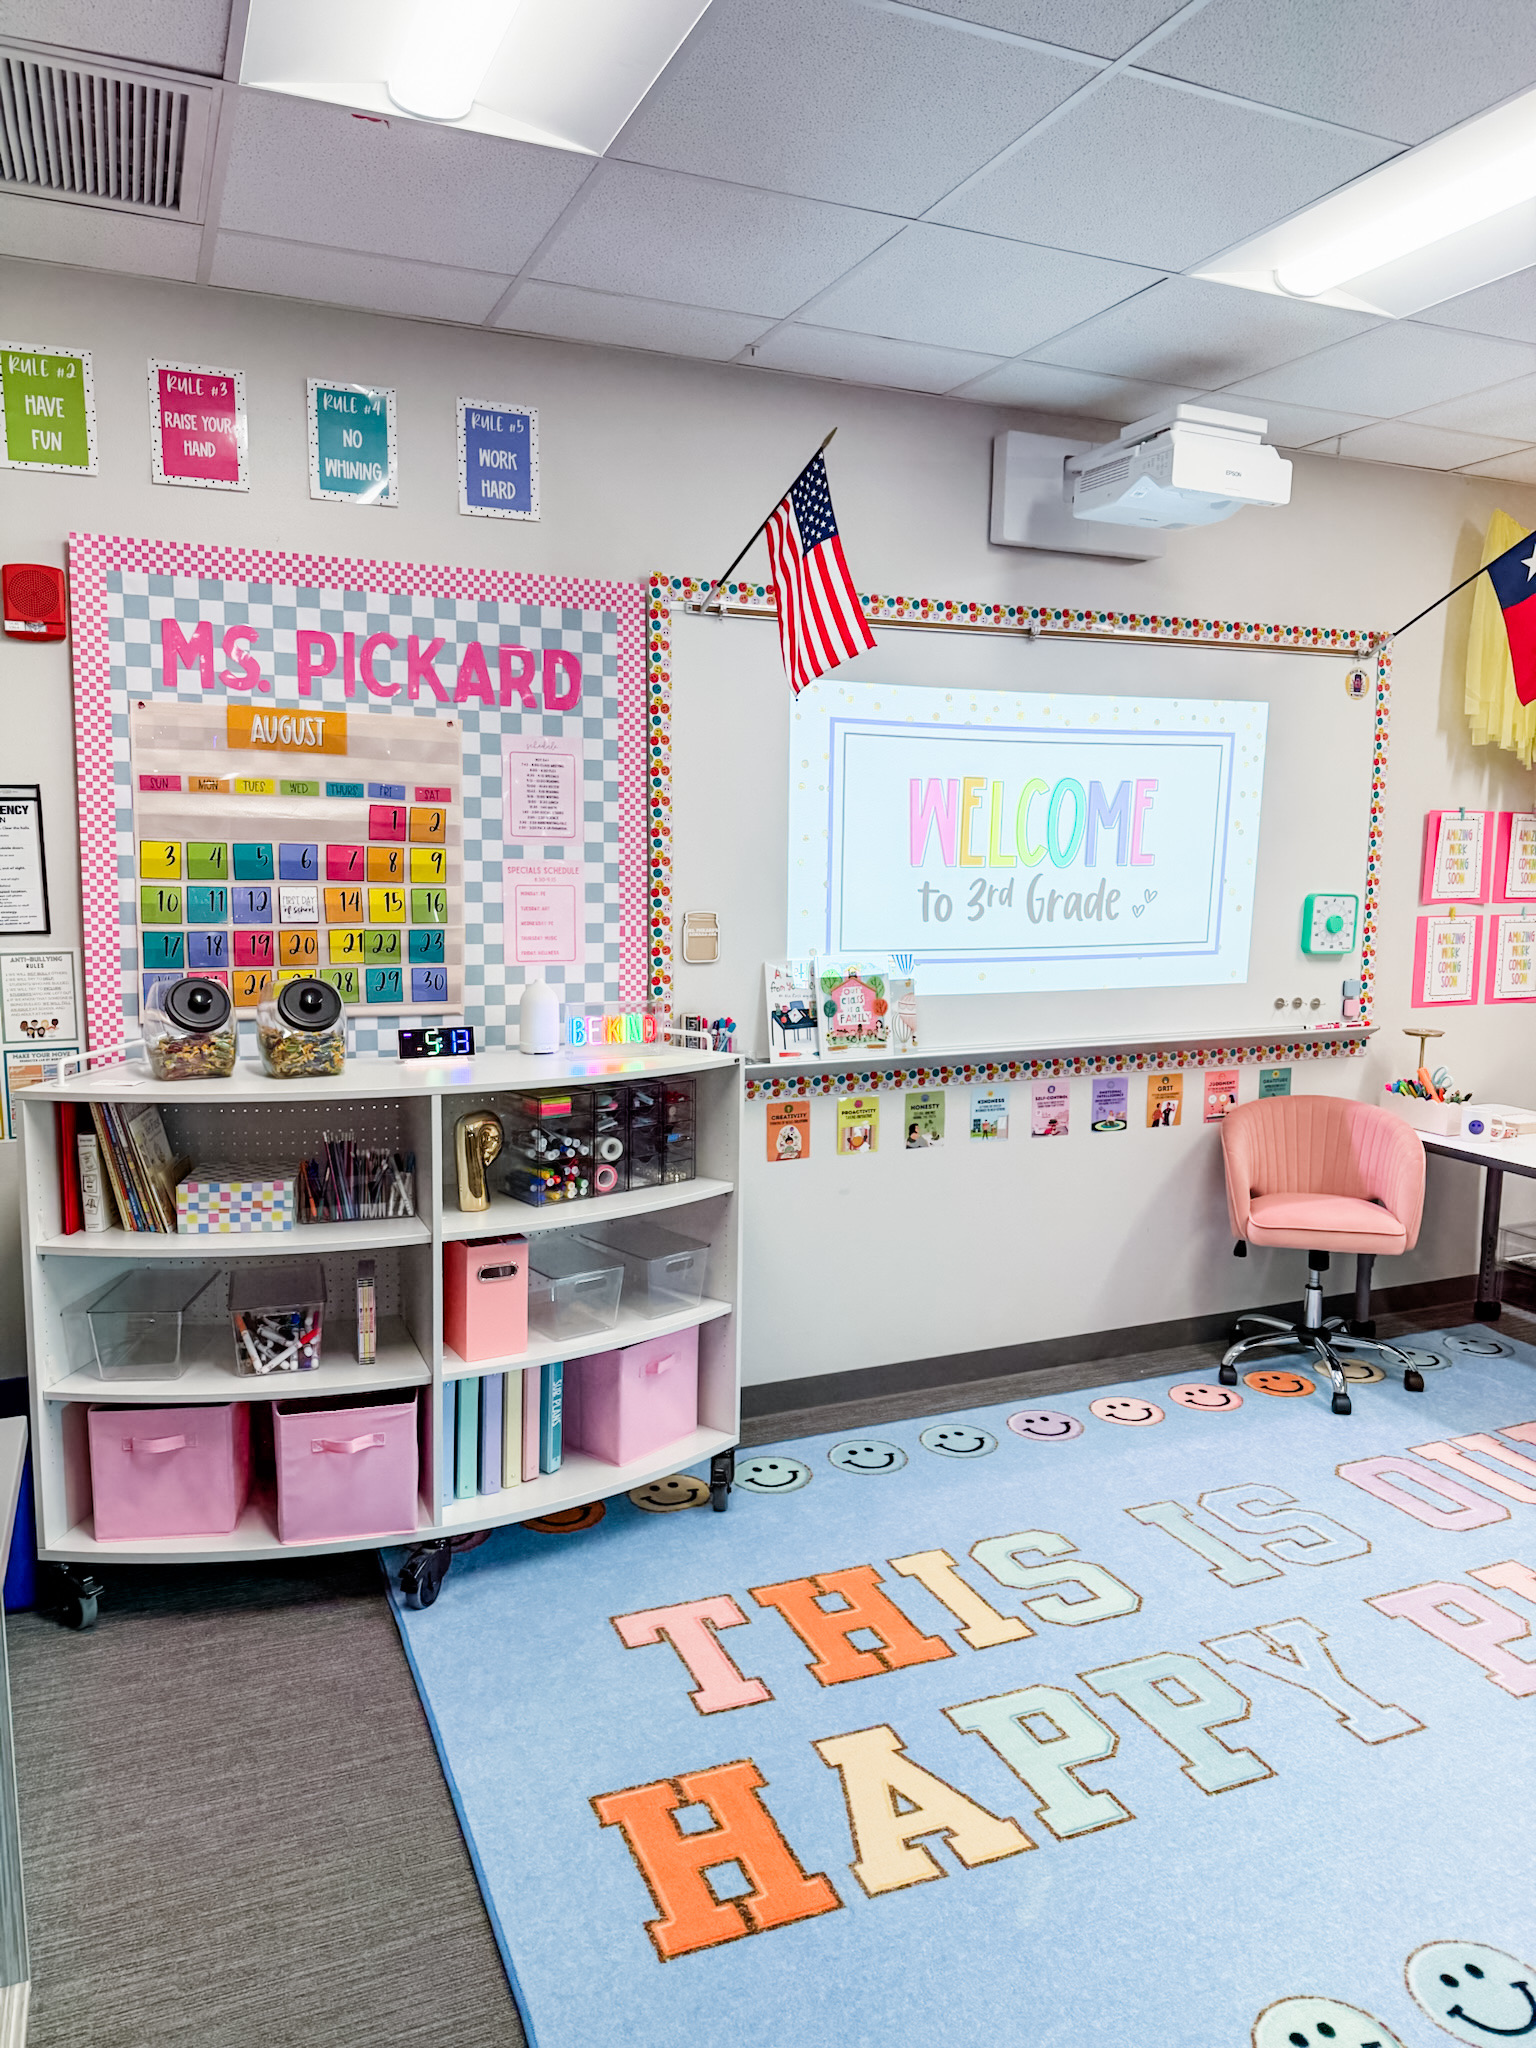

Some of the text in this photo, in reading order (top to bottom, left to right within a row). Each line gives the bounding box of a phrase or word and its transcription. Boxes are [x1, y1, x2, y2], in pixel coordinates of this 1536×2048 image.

[9, 355, 76, 378] RULE #2
[167, 374, 227, 396] RULE #3
[25, 395, 65, 418] HAVE
[323, 392, 381, 416] RULE #4
[165, 411, 232, 434] RAISE YOUR
[472, 412, 524, 433] RULE #5
[32, 429, 62, 451] FUN
[184, 440, 216, 458] HAND
[343, 429, 362, 448] NO
[325, 458, 382, 481] WHINING
[479, 448, 517, 470] WORK
[481, 480, 516, 500] HARD
[162, 618, 582, 711] MS. PICKARD
[251, 714, 326, 746] AUGUST
[150, 778, 440, 801] SUN MON TUES WED THURS FRI SAT
[391, 810, 441, 832] 1 2
[910, 777, 1158, 868] WELCOME
[1447, 829, 1473, 841] AMAZING
[164, 846, 443, 874] 3 4 5 6 7 8 9
[1449, 843, 1468, 856] WORK
[507, 866, 579, 875] SPECIALS SCHEDULE
[1446, 858, 1469, 870] COMING
[1448, 872, 1465, 884] SOON
[157, 890, 268, 912] 10 11 12
[340, 891, 444, 913] 14 15 16
[918, 874, 1121, 924] to 3rd Grade
[163, 933, 443, 958] 17 18 19 20 21 22 23
[1438, 933, 1466, 945] AMAZING
[1508, 931, 1535, 943] AMAZING
[1442, 947, 1460, 959] WORK
[1512, 945, 1530, 957] WORK
[1438, 961, 1461, 973] COMING
[1509, 959, 1531, 970] COMING
[332, 971, 444, 993] 28 29 30
[1441, 976, 1458, 988] SOON
[1511, 973, 1527, 985] SOON
[603, 1012, 658, 1045] KIND
[840, 1013, 870, 1024] FAMILY
[610, 1529, 1142, 1715] THIS
[1125, 1483, 1372, 1588] IS
[588, 1617, 1428, 1964] HAPPY
